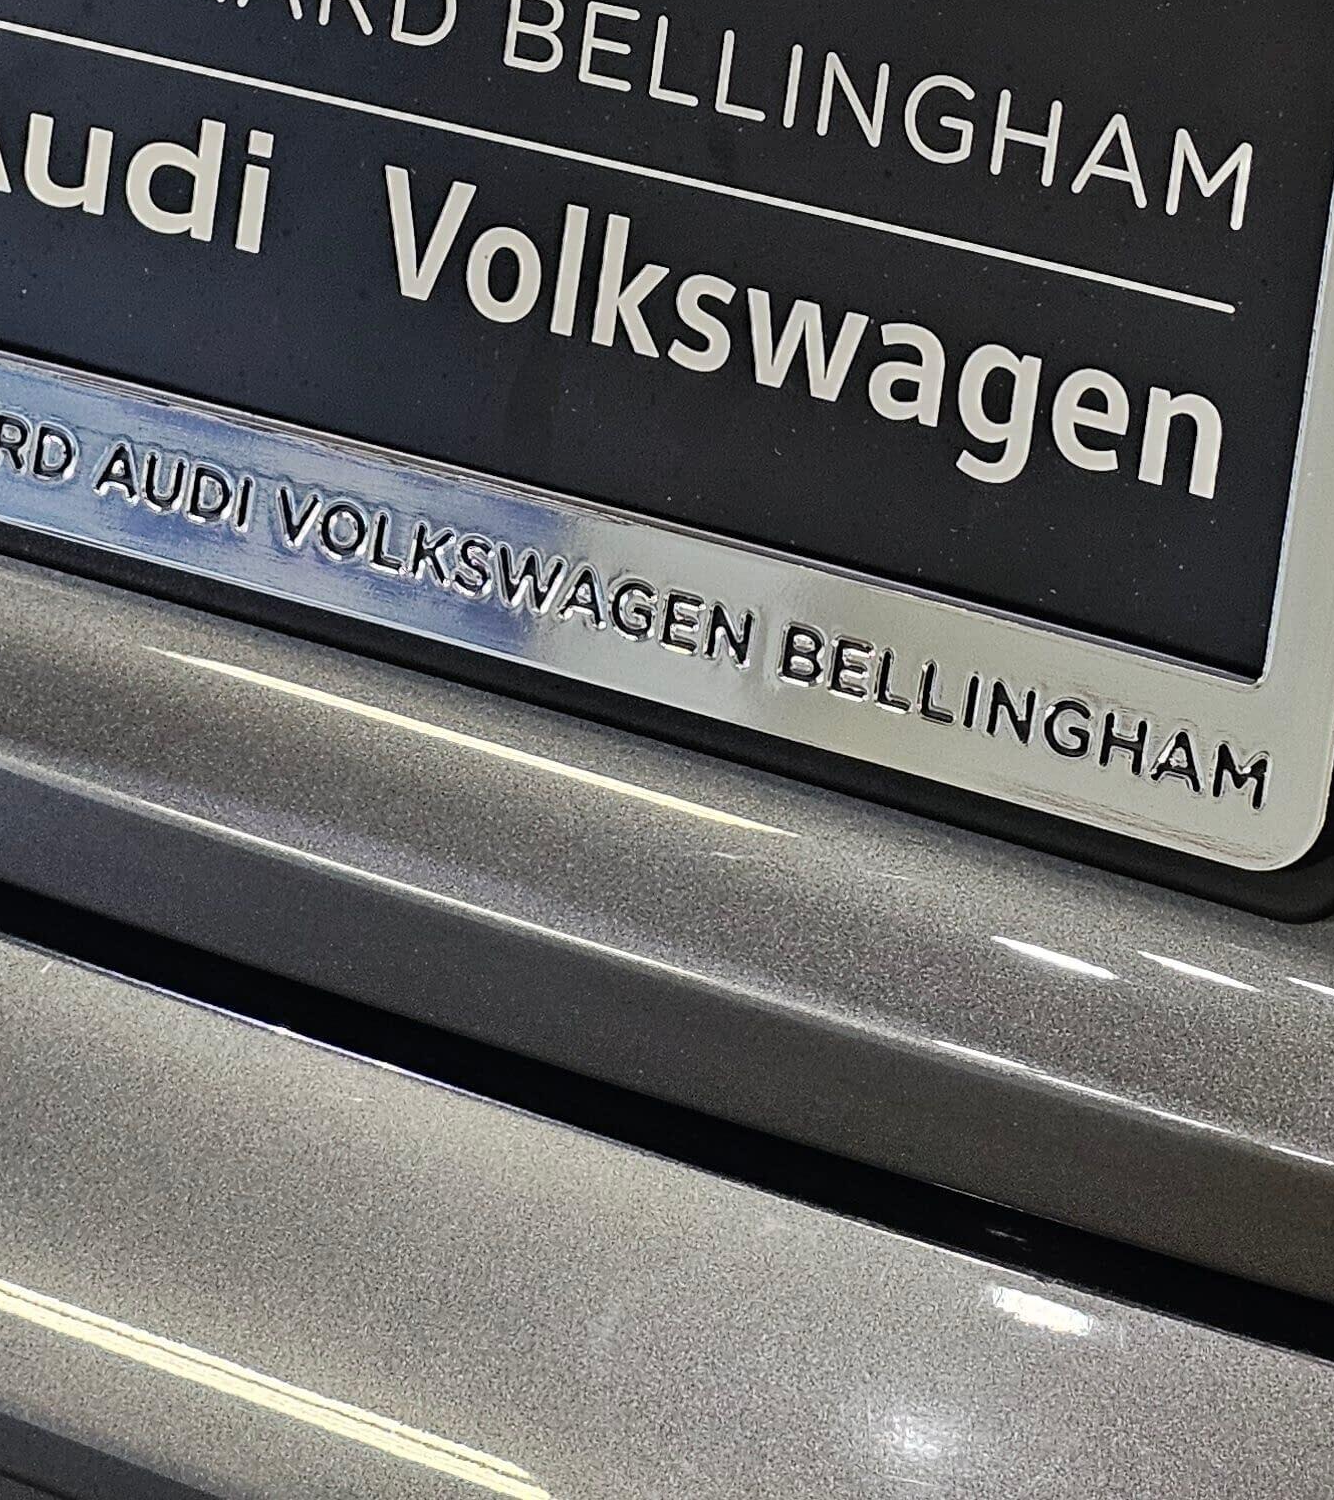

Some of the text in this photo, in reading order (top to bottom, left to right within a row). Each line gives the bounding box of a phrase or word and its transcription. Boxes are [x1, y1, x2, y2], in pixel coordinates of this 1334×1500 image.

[385, 164, 1224, 500] Volkswagen
[95, 441, 255, 532] AUDI
[277, 486, 756, 669] VOLKSWAGEN
[777, 621, 1271, 810] BELLINGHAM
